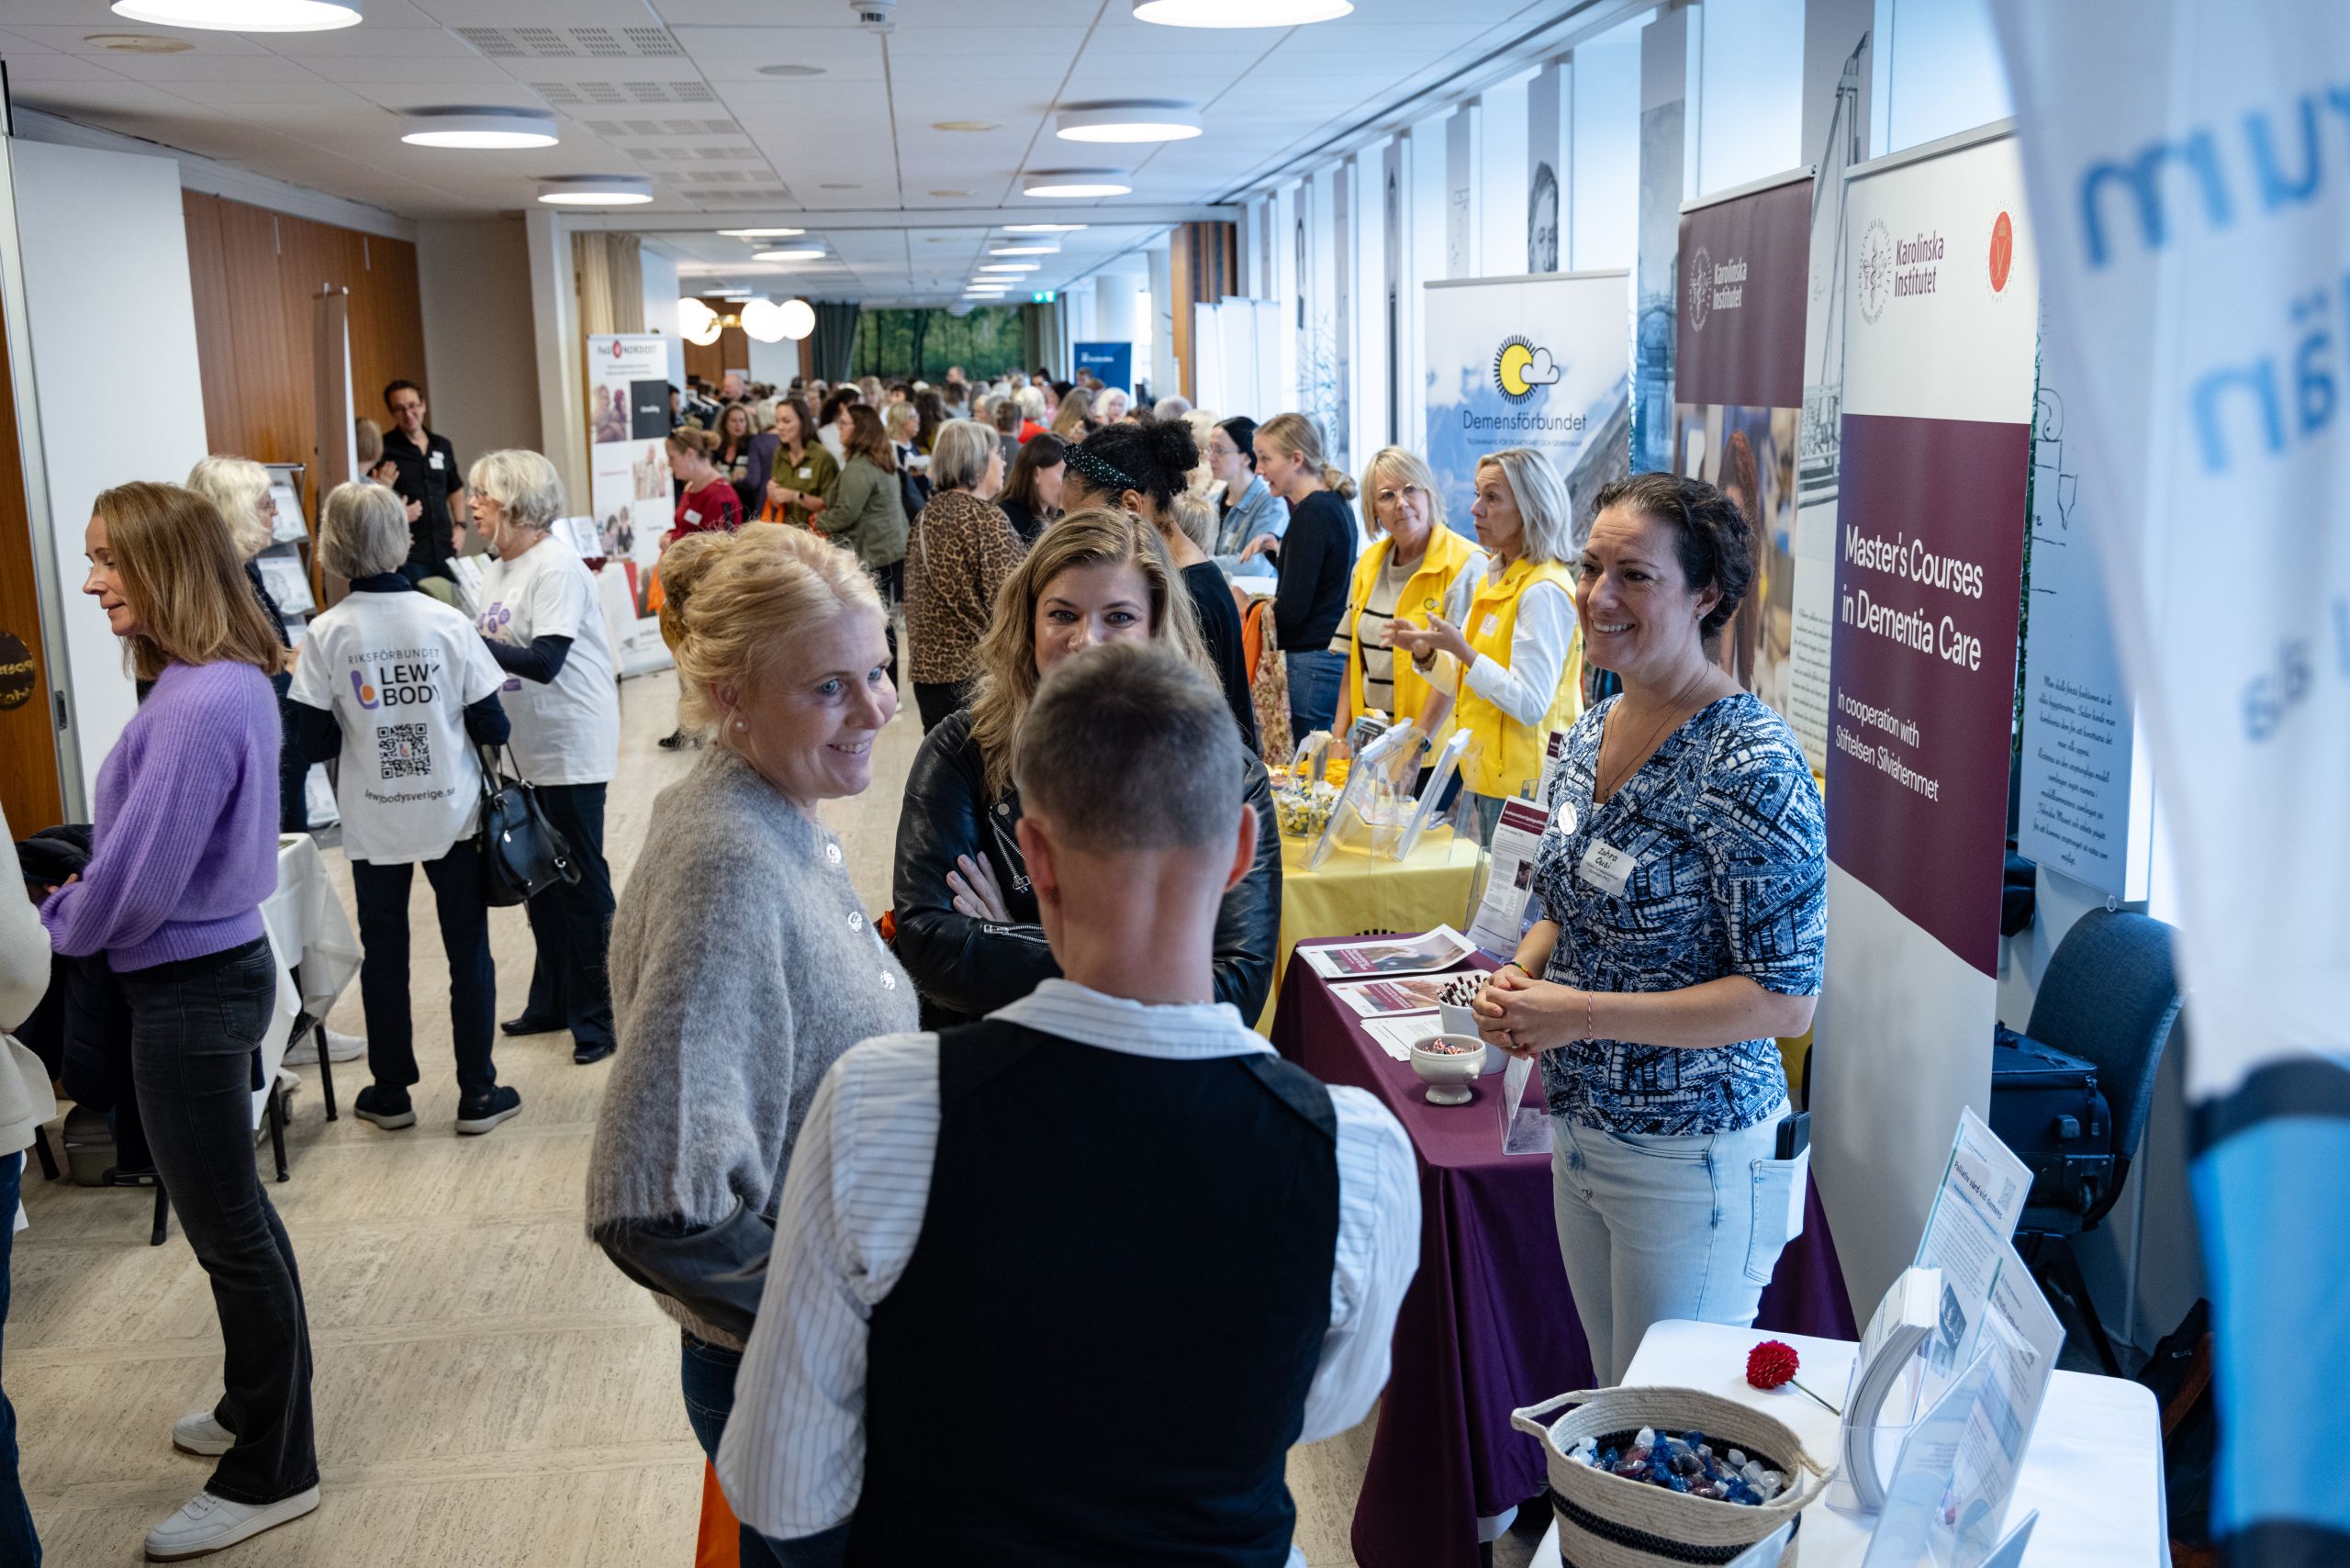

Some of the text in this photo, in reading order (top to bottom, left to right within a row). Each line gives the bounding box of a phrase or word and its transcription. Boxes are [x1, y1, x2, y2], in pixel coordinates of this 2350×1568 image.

[1896, 230, 1944, 266] Karolinska
[1713, 256, 1747, 285] Karolinska
[1894, 266, 1937, 297] Institutet
[1463, 409, 1586, 431] Demensförbundet
[1844, 523, 1984, 599] Master's Courses
[1841, 583, 1982, 672] in Dementia Care
[348, 648, 440, 665] RIKSFÖRBUNDET
[1837, 686, 1919, 749] In cooperation with
[1836, 724, 1940, 803] Stiftelsen Silviahemmet
[1597, 847, 1618, 863] Zahra
[1953, 1160, 1971, 1183] Palliativ
[1969, 1178, 1981, 1194] vård
[1979, 1188, 1988, 1202] vid
[1986, 1196, 2003, 1220] demens
